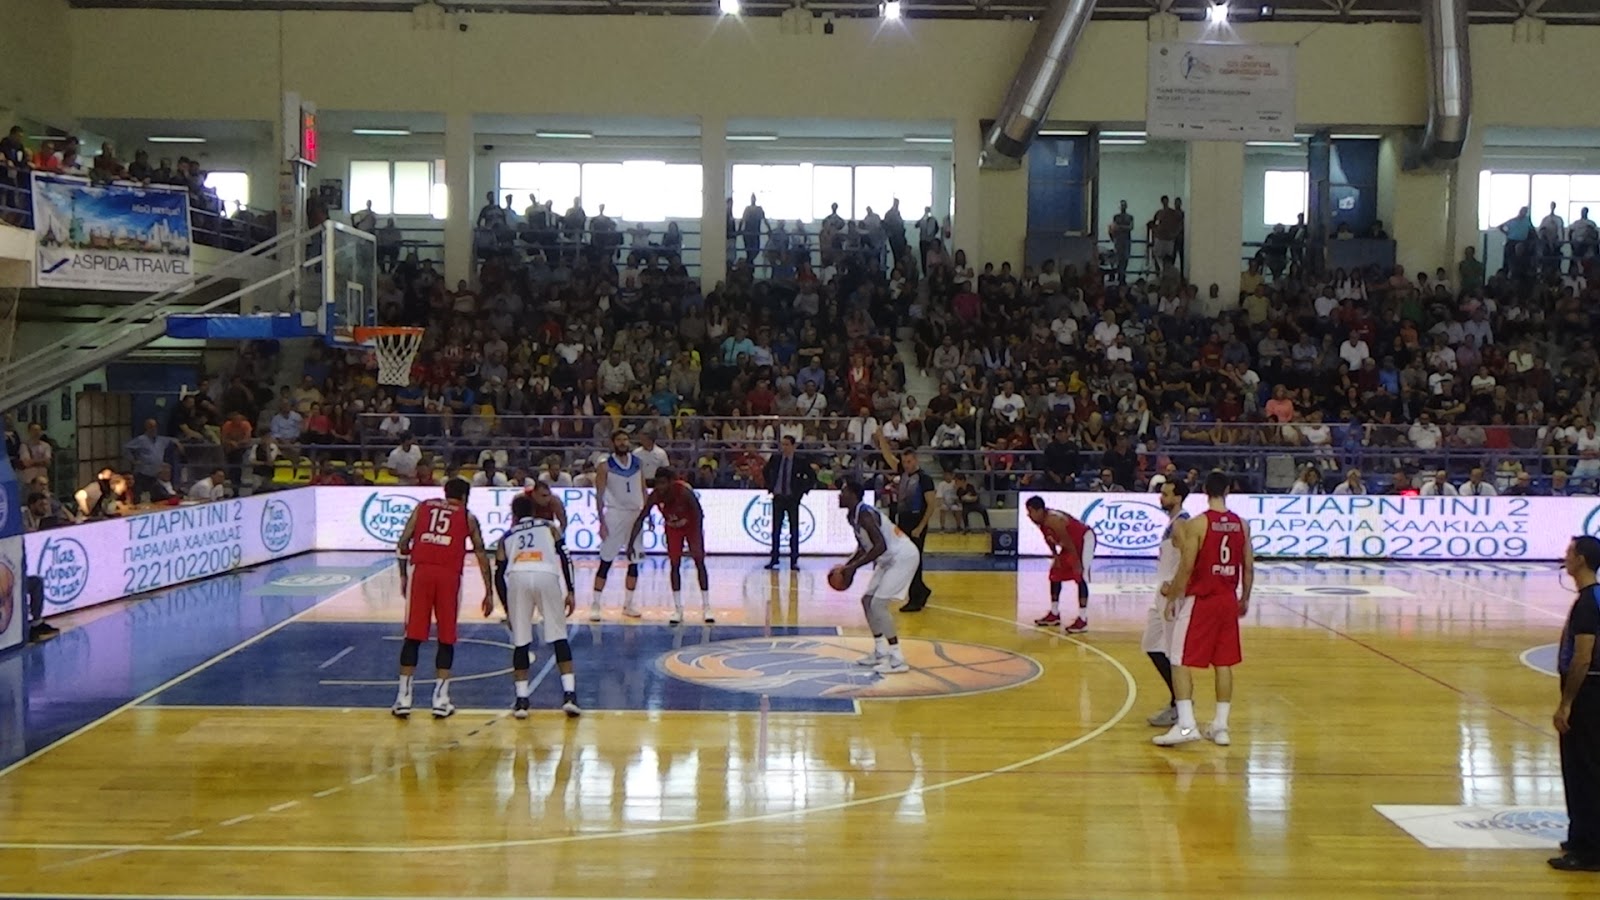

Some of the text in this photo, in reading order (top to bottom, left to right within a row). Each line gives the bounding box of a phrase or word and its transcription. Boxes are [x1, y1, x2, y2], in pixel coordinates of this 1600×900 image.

[72, 254, 190, 275] ASPIDA TRAVEL
[1249, 496, 1529, 517] ΤΖΙΑΡΝΤΙΝΙ 2
[125, 500, 243, 541] ΤΖΙΑΡΝΤΙΝΙ 2
[430, 508, 452, 534] 15
[1381, 519, 1529, 534] ΧΑΛΚΙΔΑΣ
[123, 525, 243, 563] ΠΑΡΑΛΙΑ ΧΑΛΚΙΔΑΣ
[518, 532, 535, 550] 32
[1220, 535, 1231, 564] 6
[1251, 535, 1528, 557] 2221022009
[123, 543, 242, 594] 2221022009
